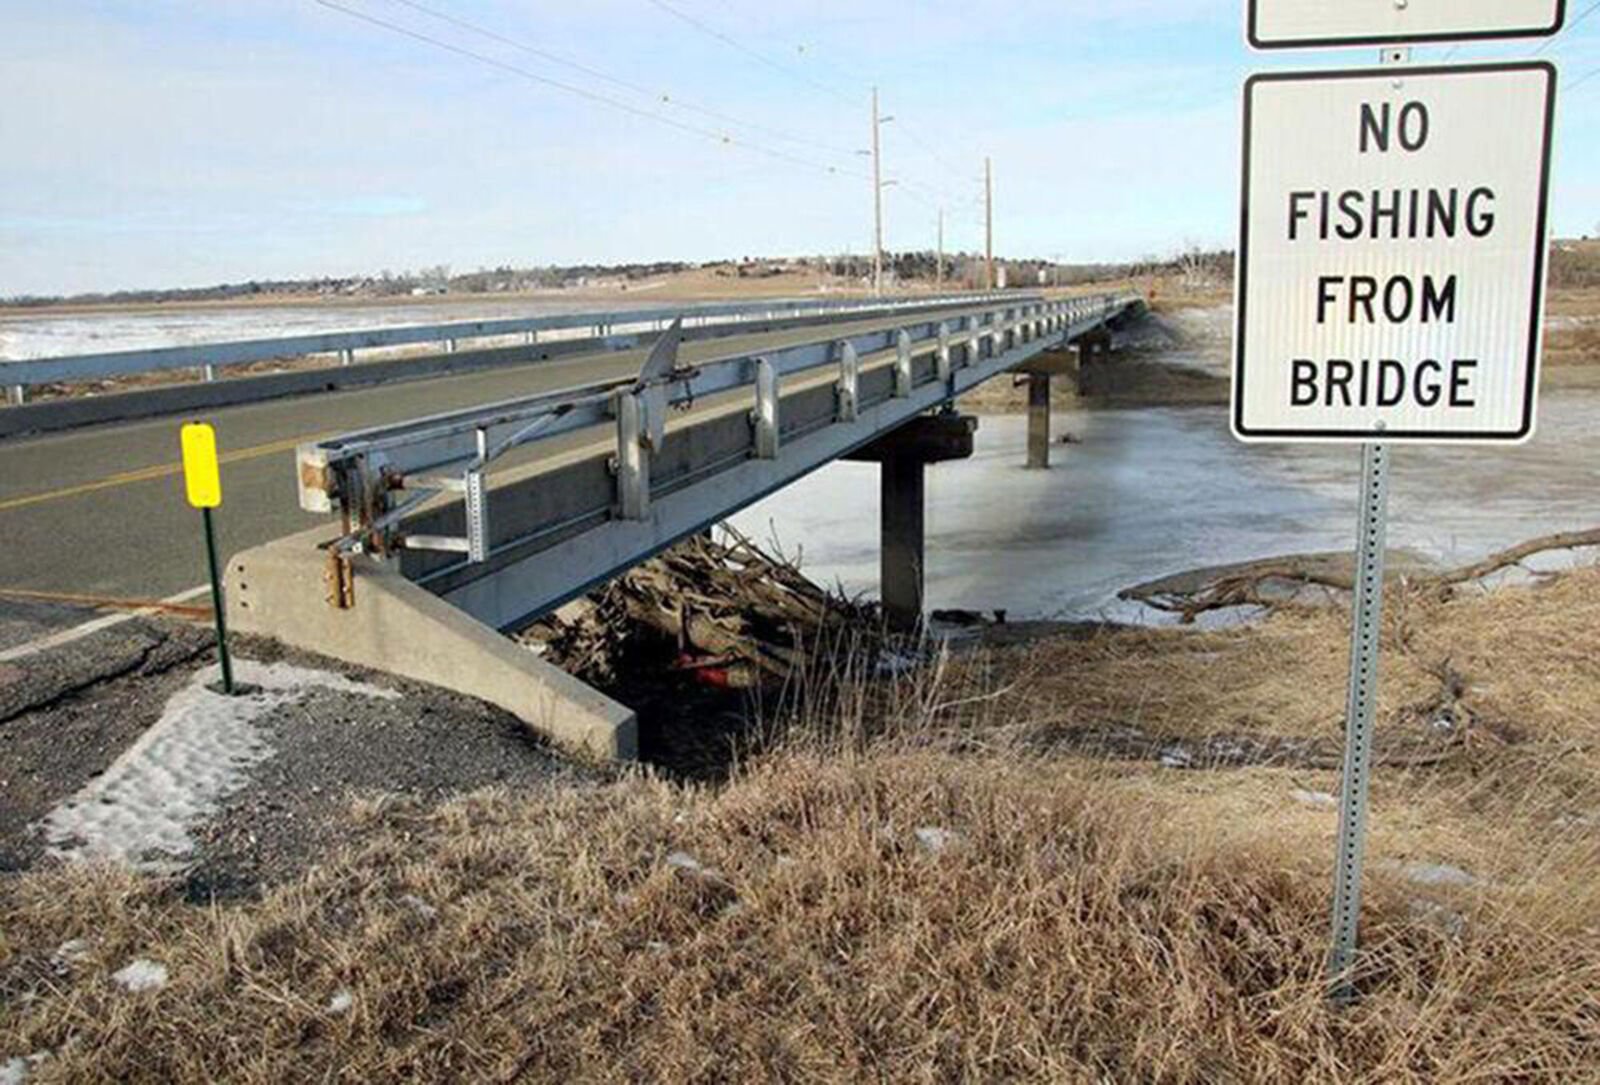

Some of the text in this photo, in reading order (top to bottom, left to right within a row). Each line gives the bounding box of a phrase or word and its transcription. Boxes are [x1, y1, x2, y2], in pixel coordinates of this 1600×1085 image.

[1360, 102, 1428, 152] NO
[1288, 188, 1495, 240] FISHING
[1317, 274, 1457, 324] FROM
[1290, 359, 1478, 407] BRIDGE
